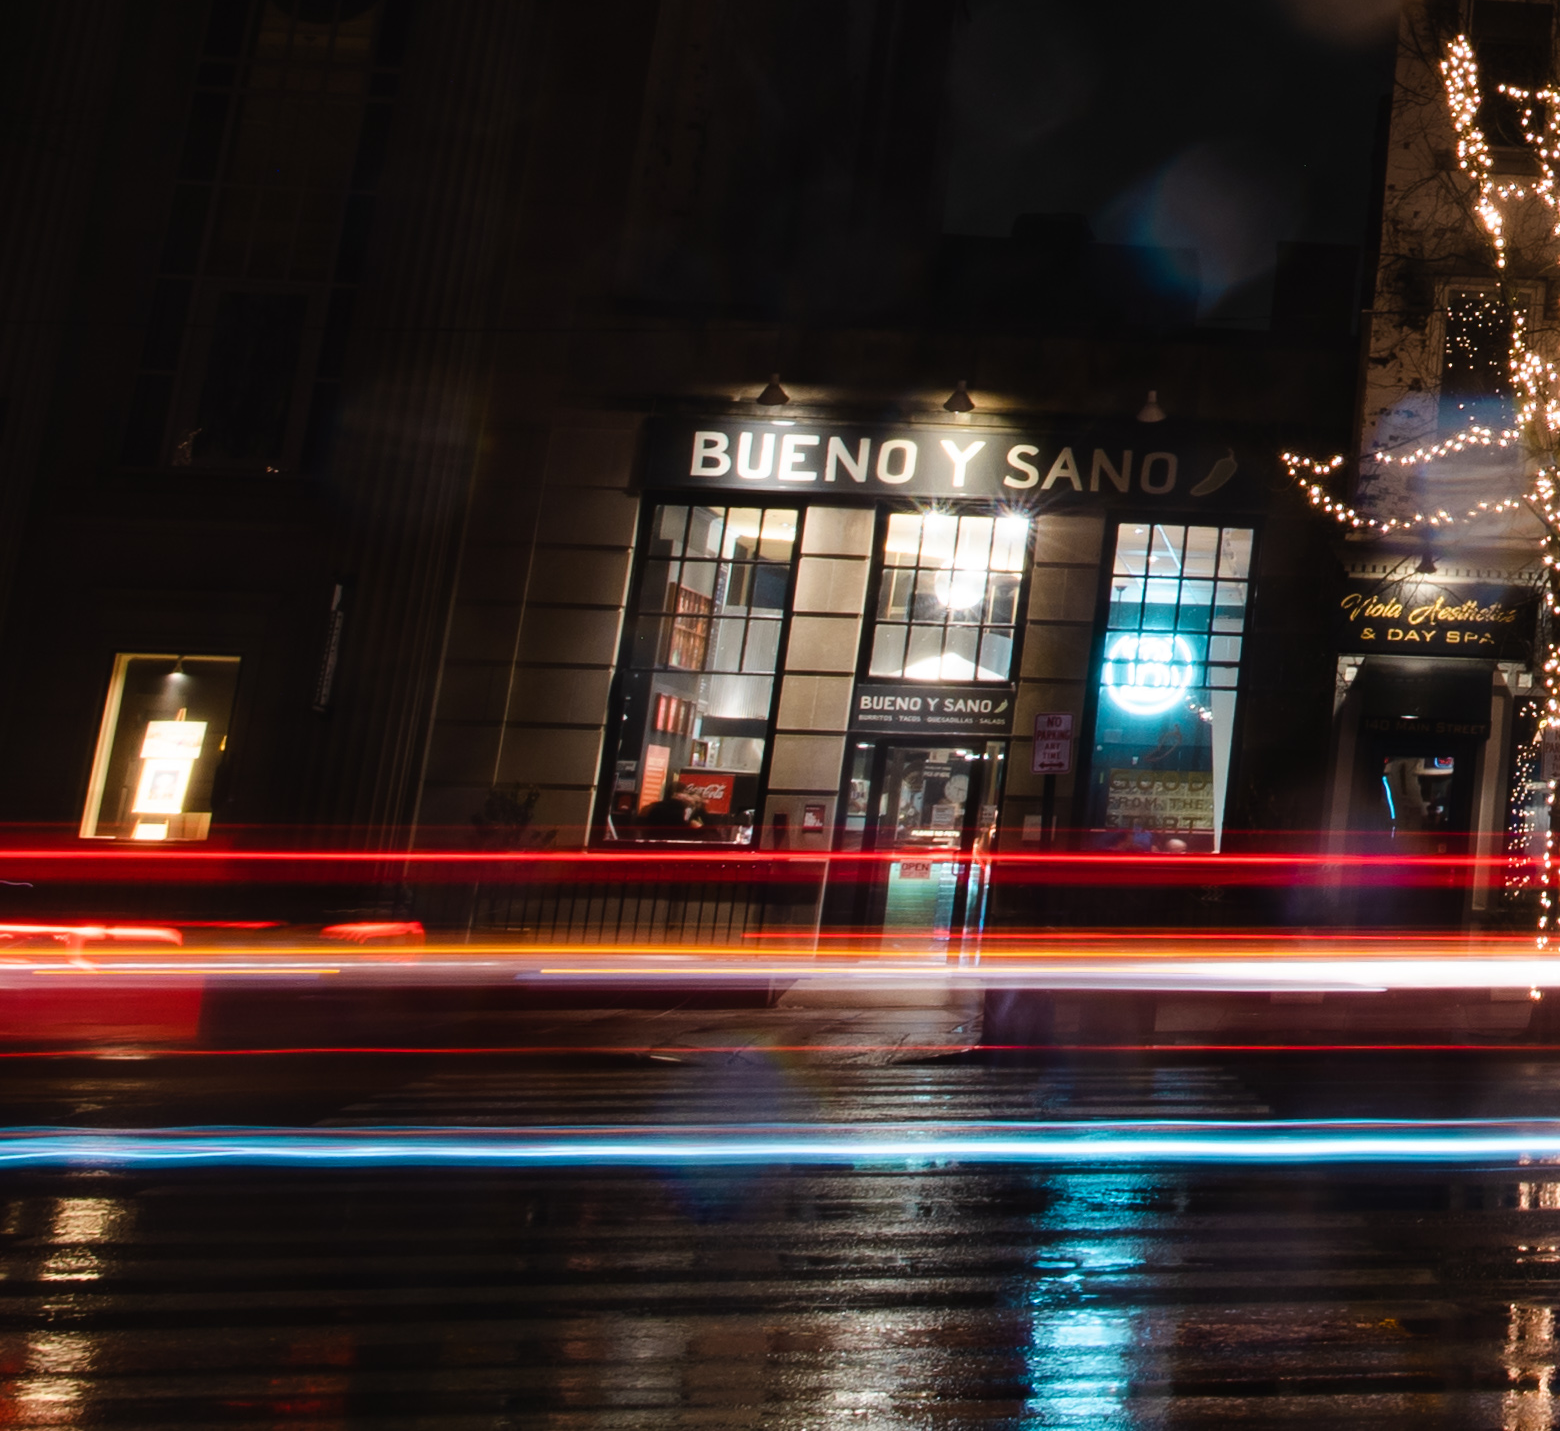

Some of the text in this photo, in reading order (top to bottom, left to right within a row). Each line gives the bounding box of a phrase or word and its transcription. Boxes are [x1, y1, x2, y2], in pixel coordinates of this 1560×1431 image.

[689, 430, 1178, 495] BUENO Y SANO
[1341, 593, 1403, 621] Viola
[1360, 627, 1495, 644] & DAY SPA
[860, 696, 992, 713] BUENO Y SANO
[1047, 717, 1062, 727] NO
[1037, 730, 1071, 740] PARKING
[1110, 770, 1208, 791] GOOD
[1108, 796, 1204, 809] FROM THE
[1106, 814, 1202, 833] START
[901, 862, 930, 871] OPEN
